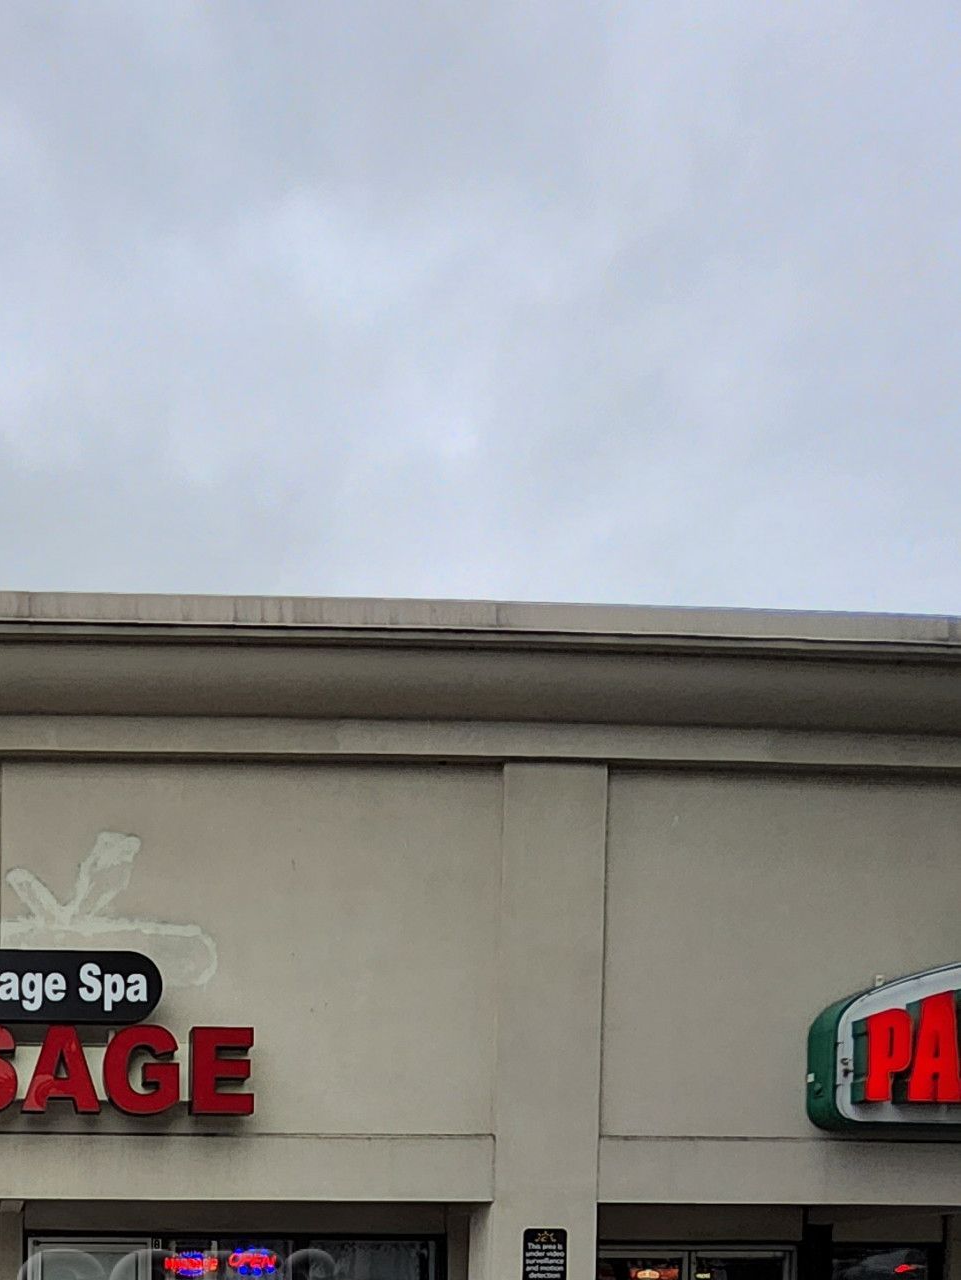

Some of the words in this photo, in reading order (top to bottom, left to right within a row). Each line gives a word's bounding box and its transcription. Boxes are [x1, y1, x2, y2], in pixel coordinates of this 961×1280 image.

[78, 963, 148, 1012] Spa
[864, 990, 961, 1102] PA
[228, 1252, 277, 1270] OPEN
[528, 1242, 541, 1250] This
